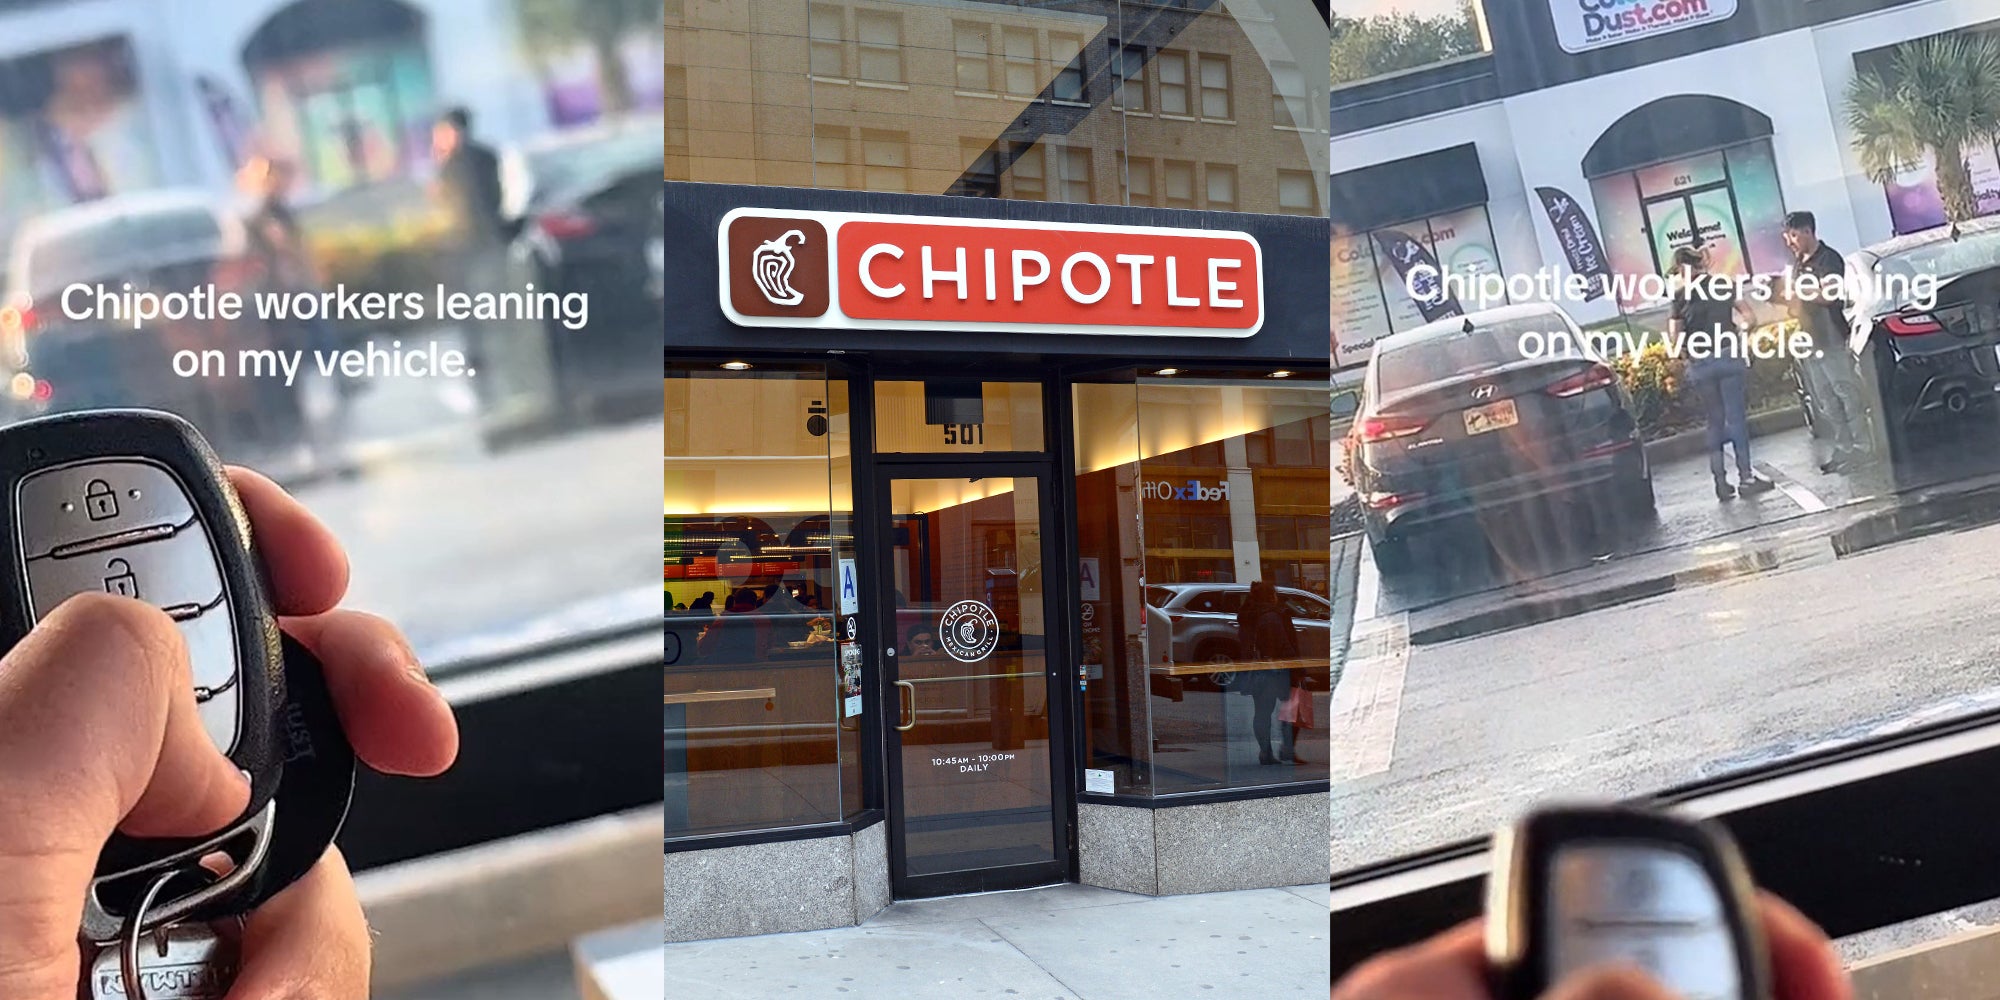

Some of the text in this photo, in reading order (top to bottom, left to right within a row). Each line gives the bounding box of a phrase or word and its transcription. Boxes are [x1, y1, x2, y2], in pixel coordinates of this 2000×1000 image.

[1582, 0, 1707, 37] Dust.com
[1673, 174, 1692, 186] 621
[1569, 215, 1593, 255] Cream
[1666, 221, 1721, 242] Welcome!
[859, 243, 1244, 309] CHIPOTLE
[943, 423, 983, 445] 501
[843, 565, 855, 599] A
[945, 604, 995, 627] CHIPOTLE
[946, 636, 994, 657] MEXICAN GRILL
[931, 757, 969, 766] 10:45AM
[978, 753, 1015, 762] 10:00PM
[960, 763, 989, 773] DAILY
